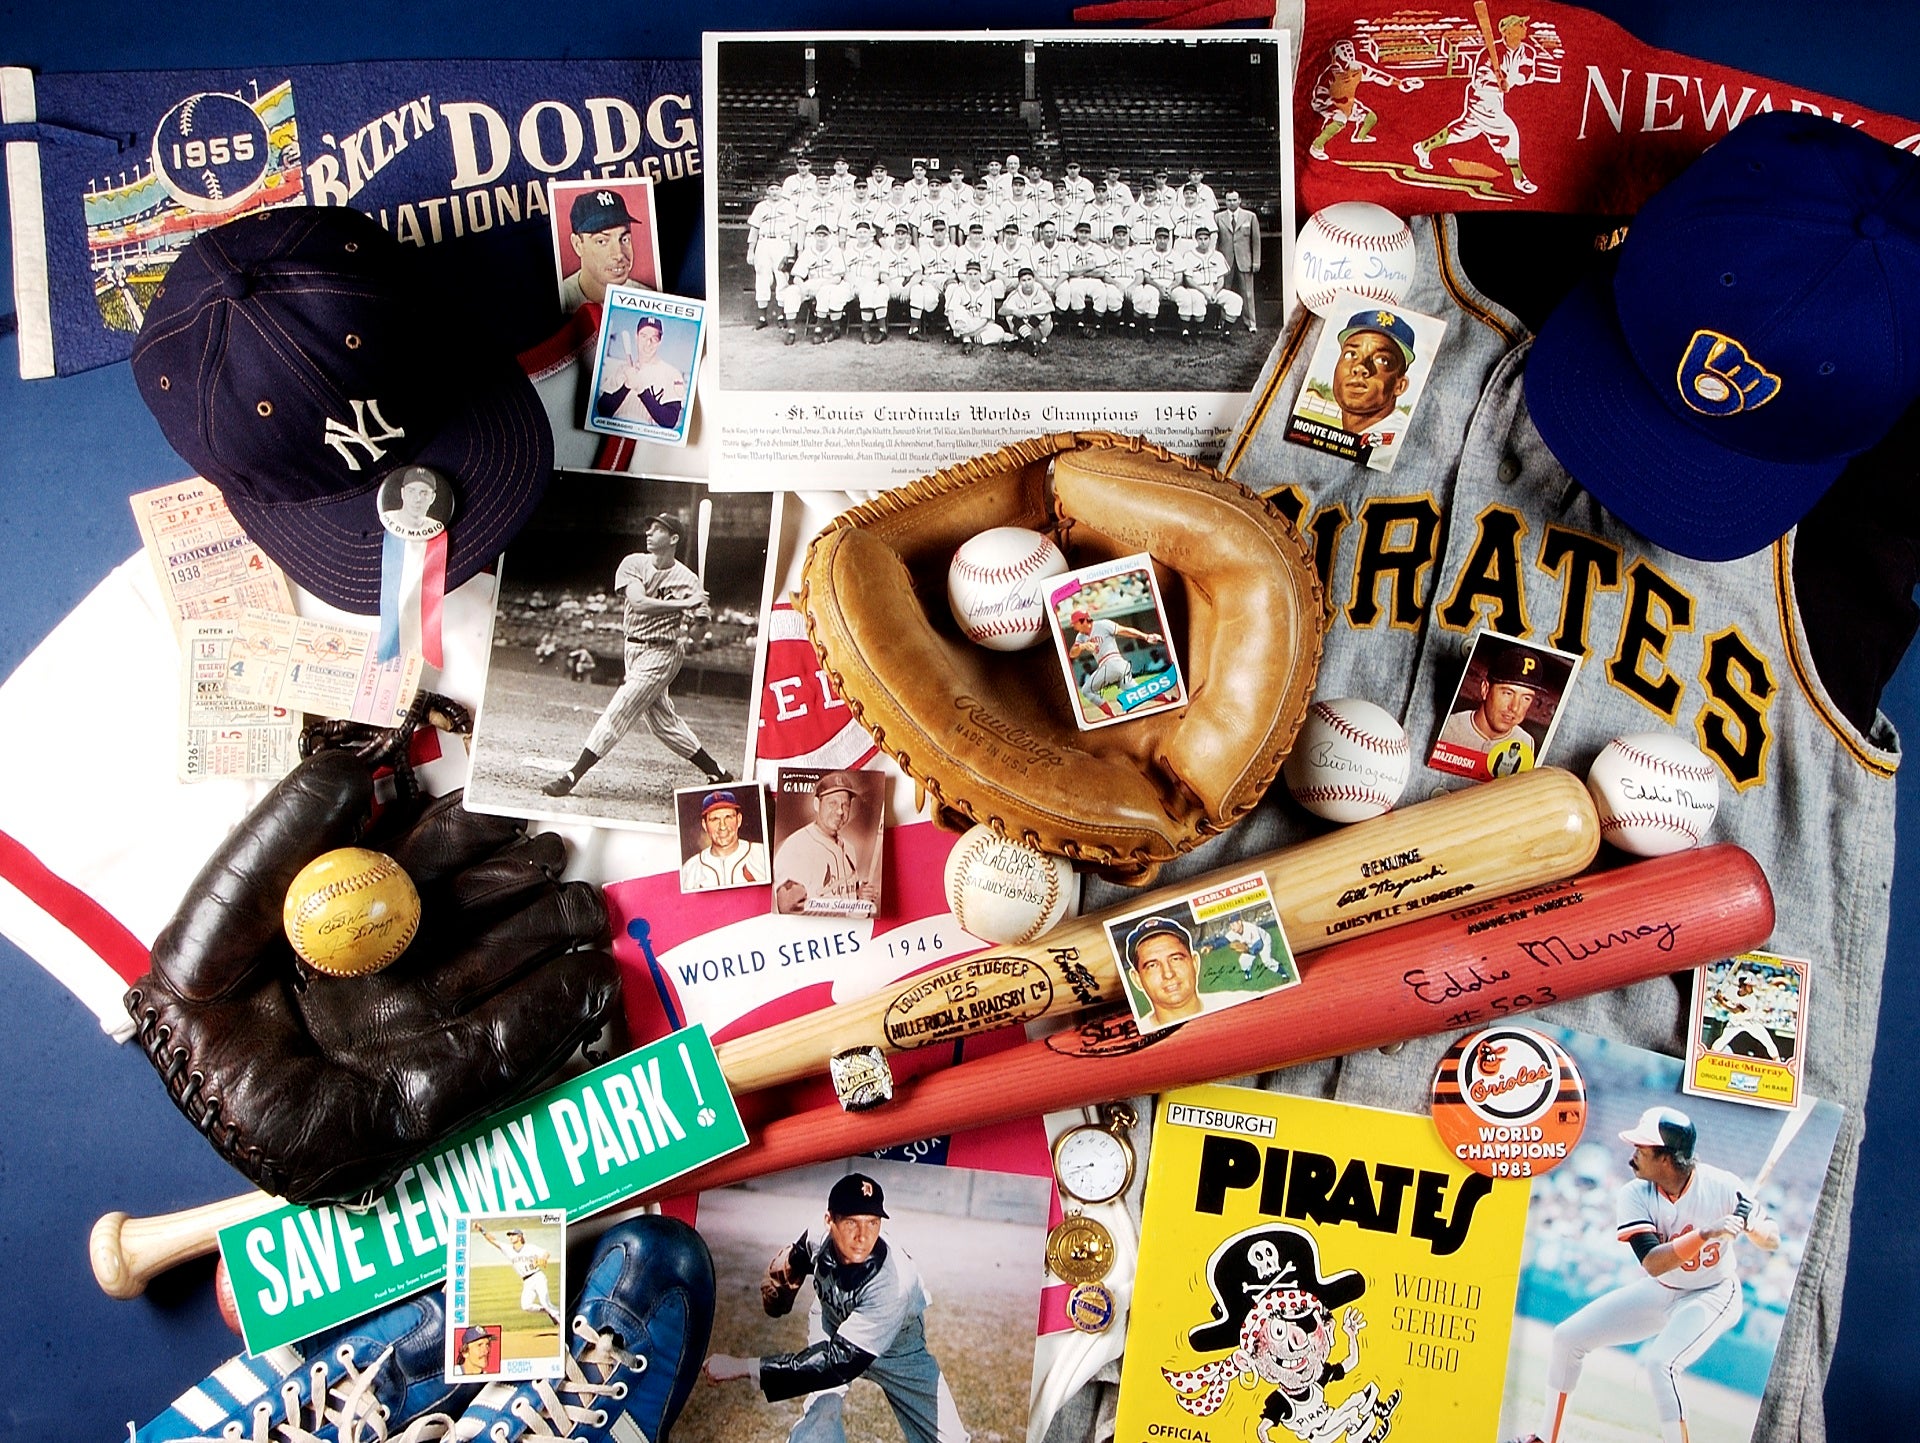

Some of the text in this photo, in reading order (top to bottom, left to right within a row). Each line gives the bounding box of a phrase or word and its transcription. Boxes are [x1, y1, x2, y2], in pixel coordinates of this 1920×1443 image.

[1577, 65, 1865, 140] NEW
[173, 132, 255, 170] 1955
[441, 95, 699, 190] DODG
[364, 178, 557, 248] NATIONA
[1303, 251, 1353, 284] Monte
[617, 295, 696, 319] YANKEES
[784, 404, 1198, 425] St. Louis Cardinals Worlds Champions 1946
[324, 399, 405, 471] NY
[1293, 418, 1328, 438] MONTE
[1327, 430, 1355, 447] IRVIN
[1312, 438, 1325, 448] NEW
[1339, 445, 1358, 457] GIANTS
[177, 489, 204, 502] Gate
[407, 522, 444, 537] MAGGIO
[171, 565, 201, 585] 1938
[248, 554, 264, 571] 4
[1086, 561, 1140, 581] JOHNNY BENCH
[199, 643, 215, 654] 15
[1270, 484, 1777, 794] IRATES
[229, 661, 245, 678] 4
[290, 664, 302, 683] 4
[1522, 657, 1536, 676] P
[1125, 676, 1171, 705] REDS
[221, 730, 243, 740] 5
[953, 695, 1064, 769] Rawlings
[956, 722, 985, 746] MADE
[986, 744, 999, 758] IN
[187, 748, 198, 774] 1936
[1431, 749, 1476, 769] MAZEROSKI
[1620, 777, 1672, 803] Eddie
[998, 844, 1037, 869] ENOS
[1360, 848, 1423, 878] GENUINE
[1197, 879, 1259, 905] EARLY WYNN
[807, 900, 874, 912] Enos Slaughter
[1326, 886, 1465, 936] LOUISVILLE SLUGGER
[678, 930, 944, 986] WORLD SERIES 1946
[1403, 921, 1681, 1005] Eddie Murray
[895, 968, 962, 1014] LOUISVILLE
[967, 960, 1030, 978] SLUGGER
[945, 980, 979, 1003] 125
[957, 1006, 970, 1022] &
[970, 987, 1026, 1018] BRADSBY
[1700, 1072, 1727, 1082] ORIOLES
[1708, 1057, 1784, 1077] Eddie Murray
[1470, 1063, 1552, 1103] Orioles
[1771, 1084, 1788, 1092] BASE
[1171, 1105, 1273, 1136] PITTSBURGH
[1478, 1126, 1544, 1143] WORLD
[1455, 1141, 1568, 1160] CHAMPIONS
[1491, 1161, 1532, 1177] 1983
[245, 1205, 377, 1317] SAVE
[379, 1113, 551, 1267] FENWAY
[548, 1057, 687, 1187] PARK
[1195, 1134, 1495, 1257] PIRATES
[1393, 1272, 1482, 1311] WORLD
[1391, 1305, 1477, 1344] SERIES
[1404, 1340, 1460, 1373] 1960
[507, 1366, 533, 1374] YOUNT
[1148, 1423, 1212, 1443] OFFICIAL
